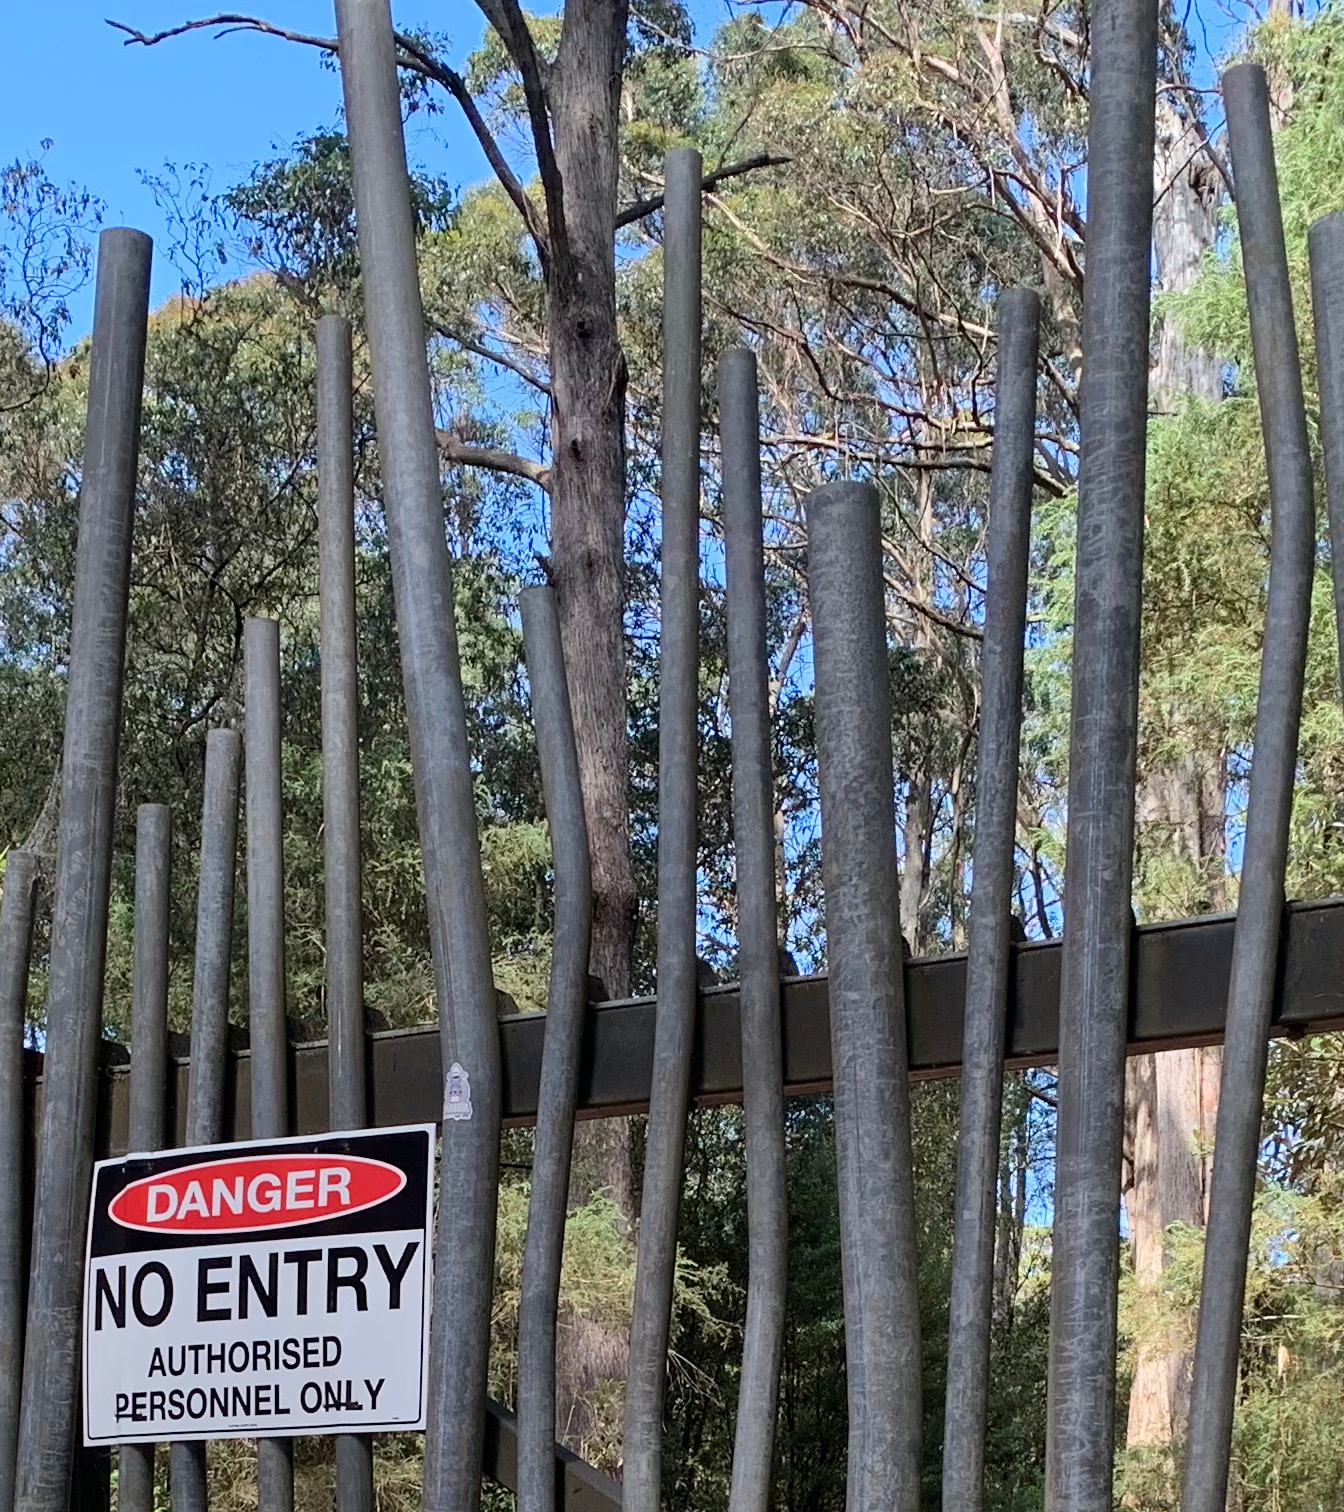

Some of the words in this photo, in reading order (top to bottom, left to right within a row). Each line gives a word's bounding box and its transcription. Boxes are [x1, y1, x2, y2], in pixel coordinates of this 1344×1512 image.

[146, 1167, 351, 1222] DANGER
[94, 1261, 174, 1331] NO
[196, 1241, 420, 1322] ENTRY
[148, 1336, 342, 1378] AUTHORISED
[115, 1384, 290, 1423] PERSONNEL
[300, 1378, 385, 1413] ONLY
